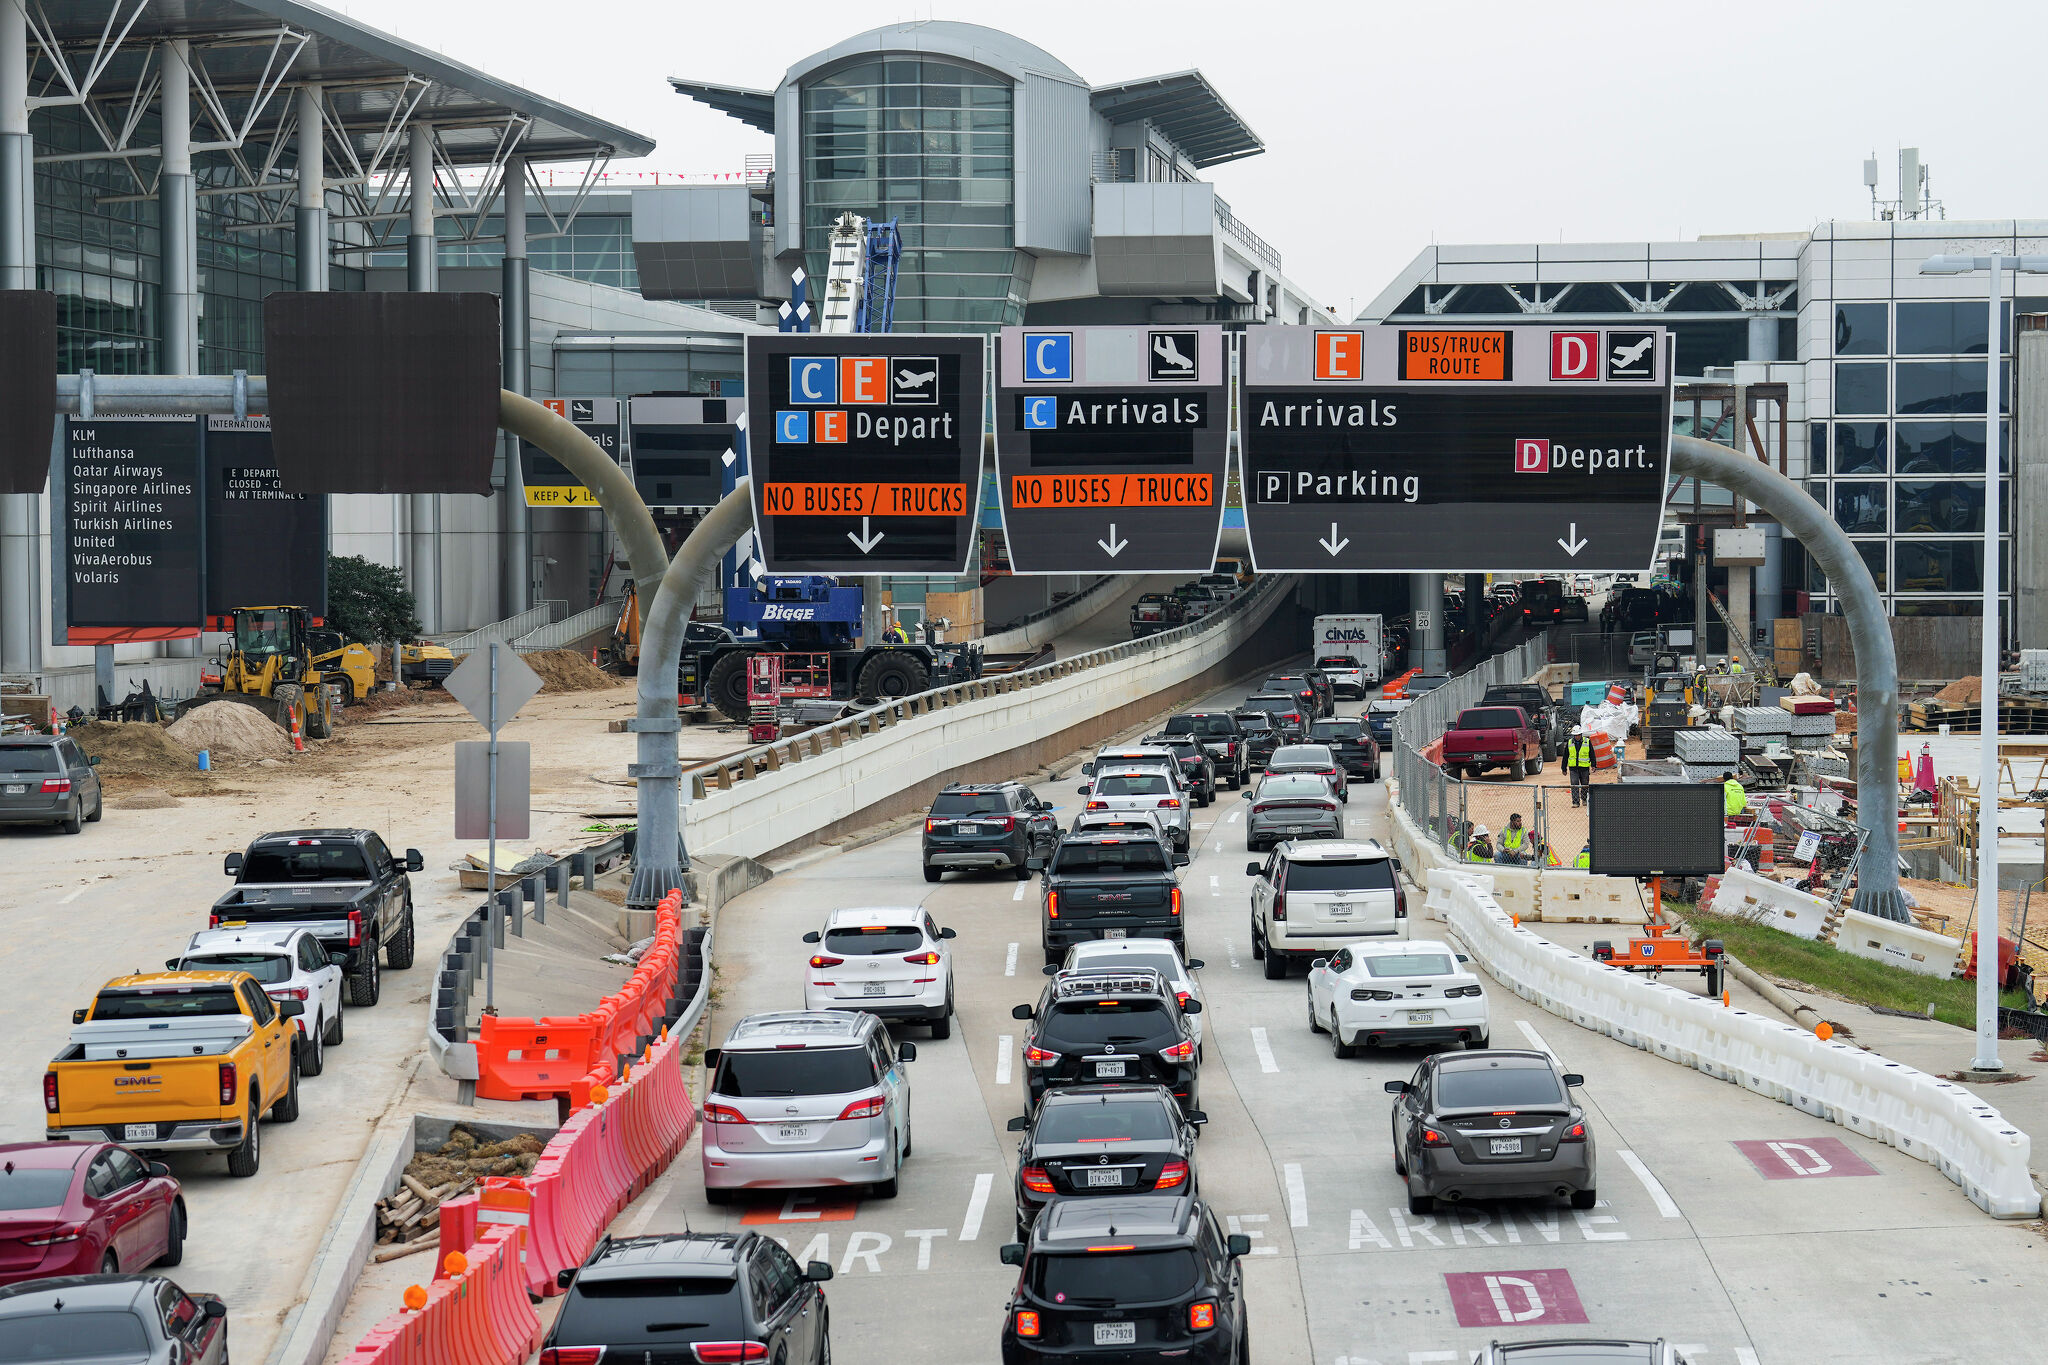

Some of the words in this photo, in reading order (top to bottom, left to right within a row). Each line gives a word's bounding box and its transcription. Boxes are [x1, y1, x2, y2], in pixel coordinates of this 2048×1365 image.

[1408, 336, 1502, 354] BUS/TRUCK
[1036, 339, 1057, 374] C
[1329, 336, 1347, 376] E
[1561, 336, 1588, 375] D
[1429, 358, 1480, 375] ROUTE
[801, 362, 823, 398] C
[854, 360, 874, 400] E
[1032, 400, 1047, 426] C
[1067, 398, 1199, 425] Arrivals
[1260, 398, 1398, 427] Arrivals
[210, 420, 271, 428] INTERNATIONA
[783, 414, 798, 440] C
[824, 413, 838, 441] E
[856, 412, 952, 446] Depart
[73, 430, 95, 441] KLM
[73, 447, 134, 459] Lufthansa
[1522, 442, 1542, 469] D
[1553, 444, 1654, 474] Depart.
[73, 465, 108, 477] Qatar
[114, 465, 163, 478] Airways
[244, 469, 279, 478] DEPART
[74, 483, 137, 496] Singapore
[143, 483, 191, 495] Airlines
[229, 480, 261, 488] CLOSED
[1016, 480, 1042, 504] NO
[1053, 478, 1110, 503] BUSES
[1120, 476, 1128, 504] /
[1137, 477, 1208, 502] TRUCKS
[1267, 476, 1280, 499] P
[1297, 470, 1419, 502] Parking
[225, 490, 235, 499] IN
[239, 490, 248, 499] AT
[534, 491, 559, 501] KEEP
[767, 486, 794, 511] NO
[805, 487, 863, 511] BUSES
[871, 484, 880, 514] /
[891, 487, 962, 511] TRUCKS
[74, 501, 107, 514] Spirit
[114, 501, 162, 513] Airlines
[74, 518, 118, 530] Turkish
[124, 518, 173, 530] Airlines
[74, 536, 115, 548] United
[74, 554, 152, 565] VivaAerobus
[75, 572, 119, 584] Volaris
[1643, 946, 1653, 956] W
[114, 1075, 162, 1086] GMC
[1767, 1142, 1832, 1175] D
[1484, 1276, 1545, 1322] D
